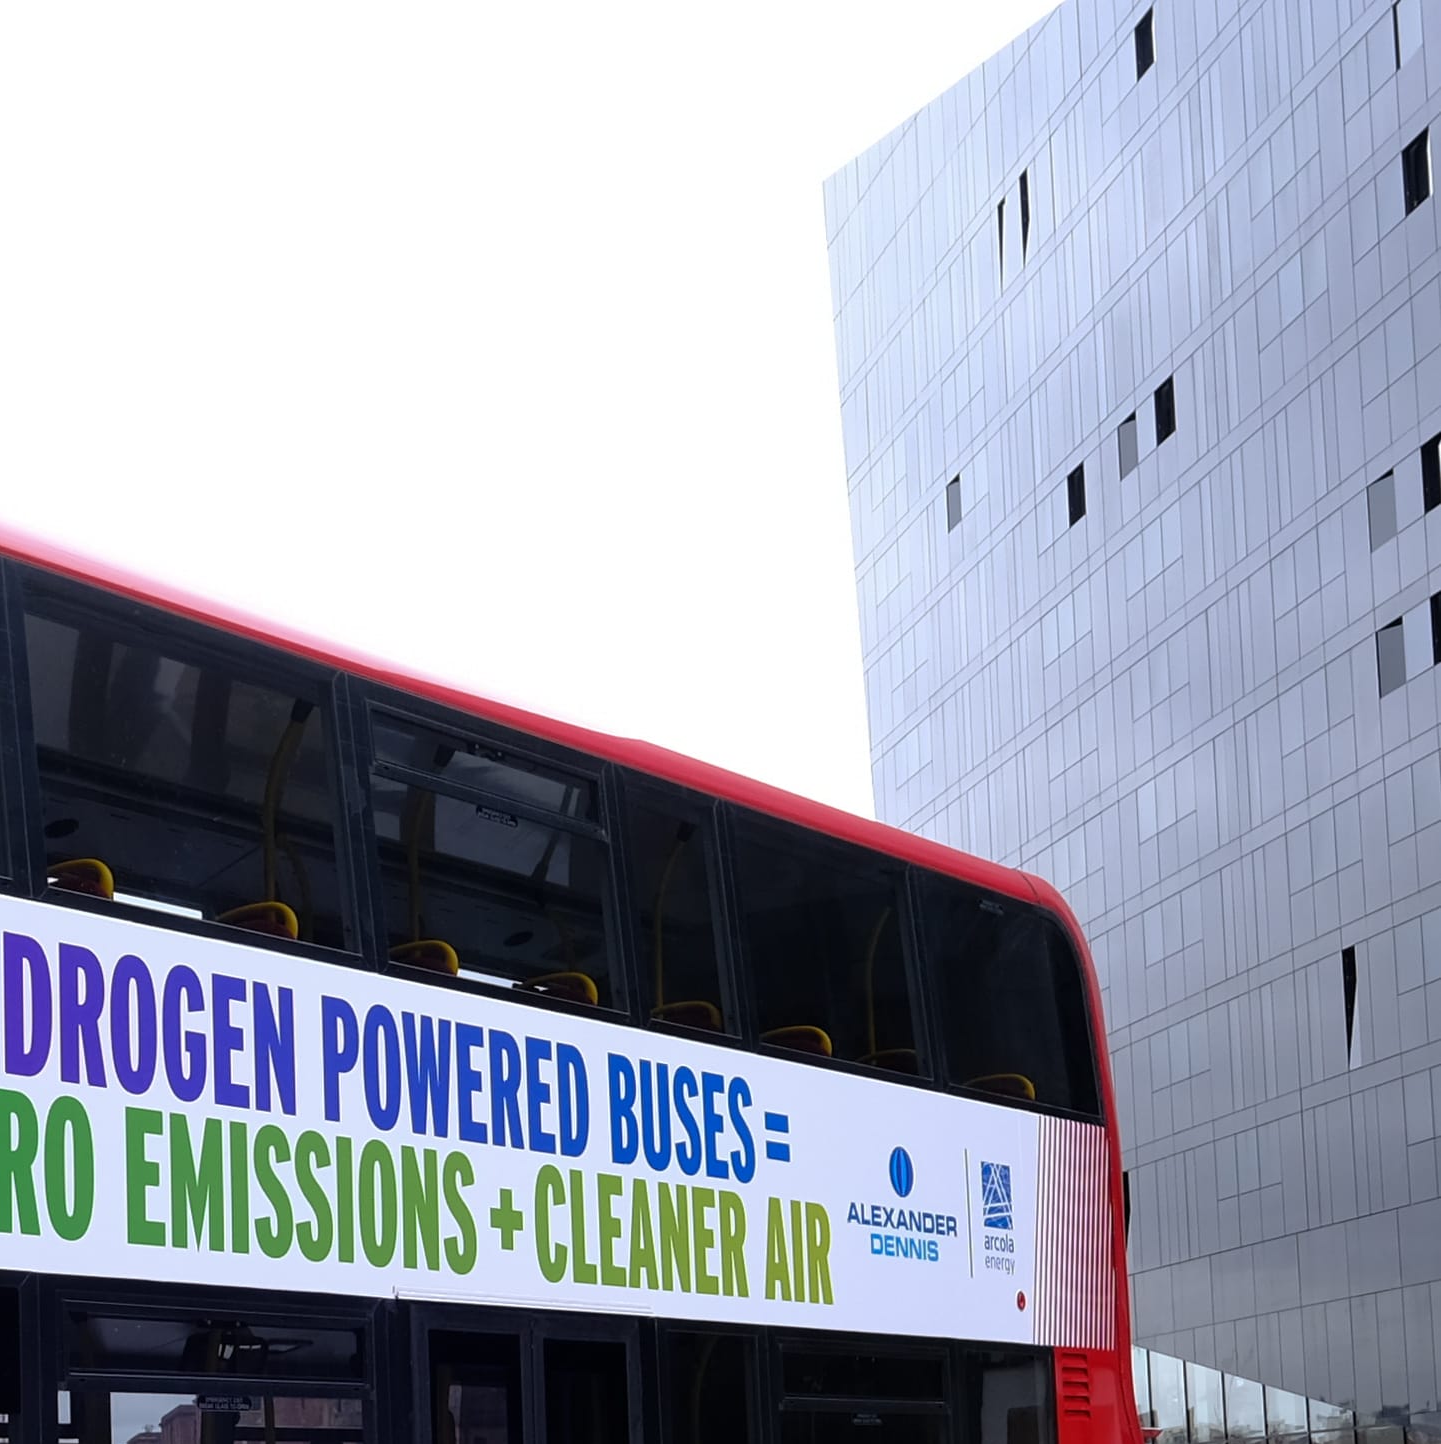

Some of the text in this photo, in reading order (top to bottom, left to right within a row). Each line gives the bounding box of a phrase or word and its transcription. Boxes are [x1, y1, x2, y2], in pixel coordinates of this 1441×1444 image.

[322, 996, 589, 1157] POWERED
[127, 1108, 476, 1273] EMISSIONS
[537, 1166, 748, 1296] CLEANER
[767, 1198, 832, 1304] AIR
[847, 1202, 958, 1237] ALEXANDER
[870, 1233, 939, 1262] DENNIS
[984, 1234, 1015, 1253] arcola
[985, 1255, 1015, 1275] energy
